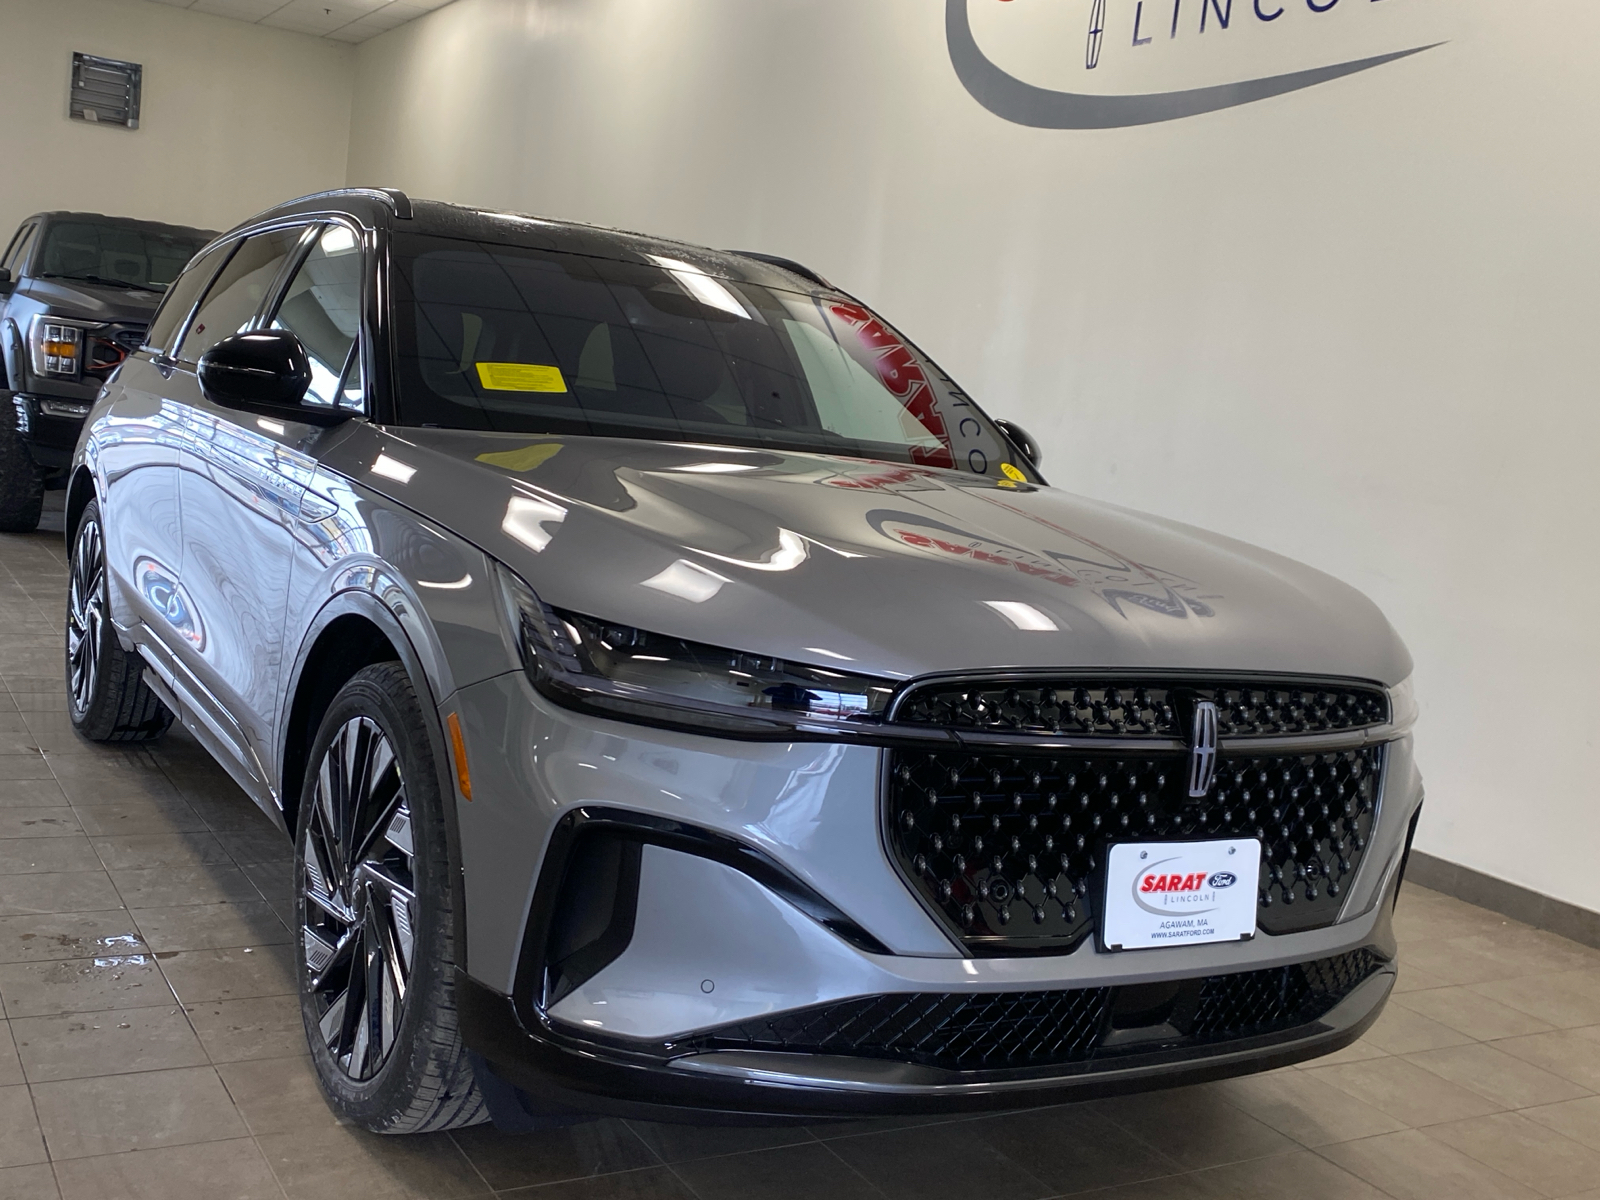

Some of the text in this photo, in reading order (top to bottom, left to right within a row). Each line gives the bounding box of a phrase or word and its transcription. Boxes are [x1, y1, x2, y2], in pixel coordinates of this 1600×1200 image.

[1140, 872, 1234, 893] SARAT Ford
[1170, 894, 1210, 903] LINCOLN
[1159, 920, 1195, 929] AGAWAM,
[1151, 928, 1215, 939] WWW.SARATFORD.COM
